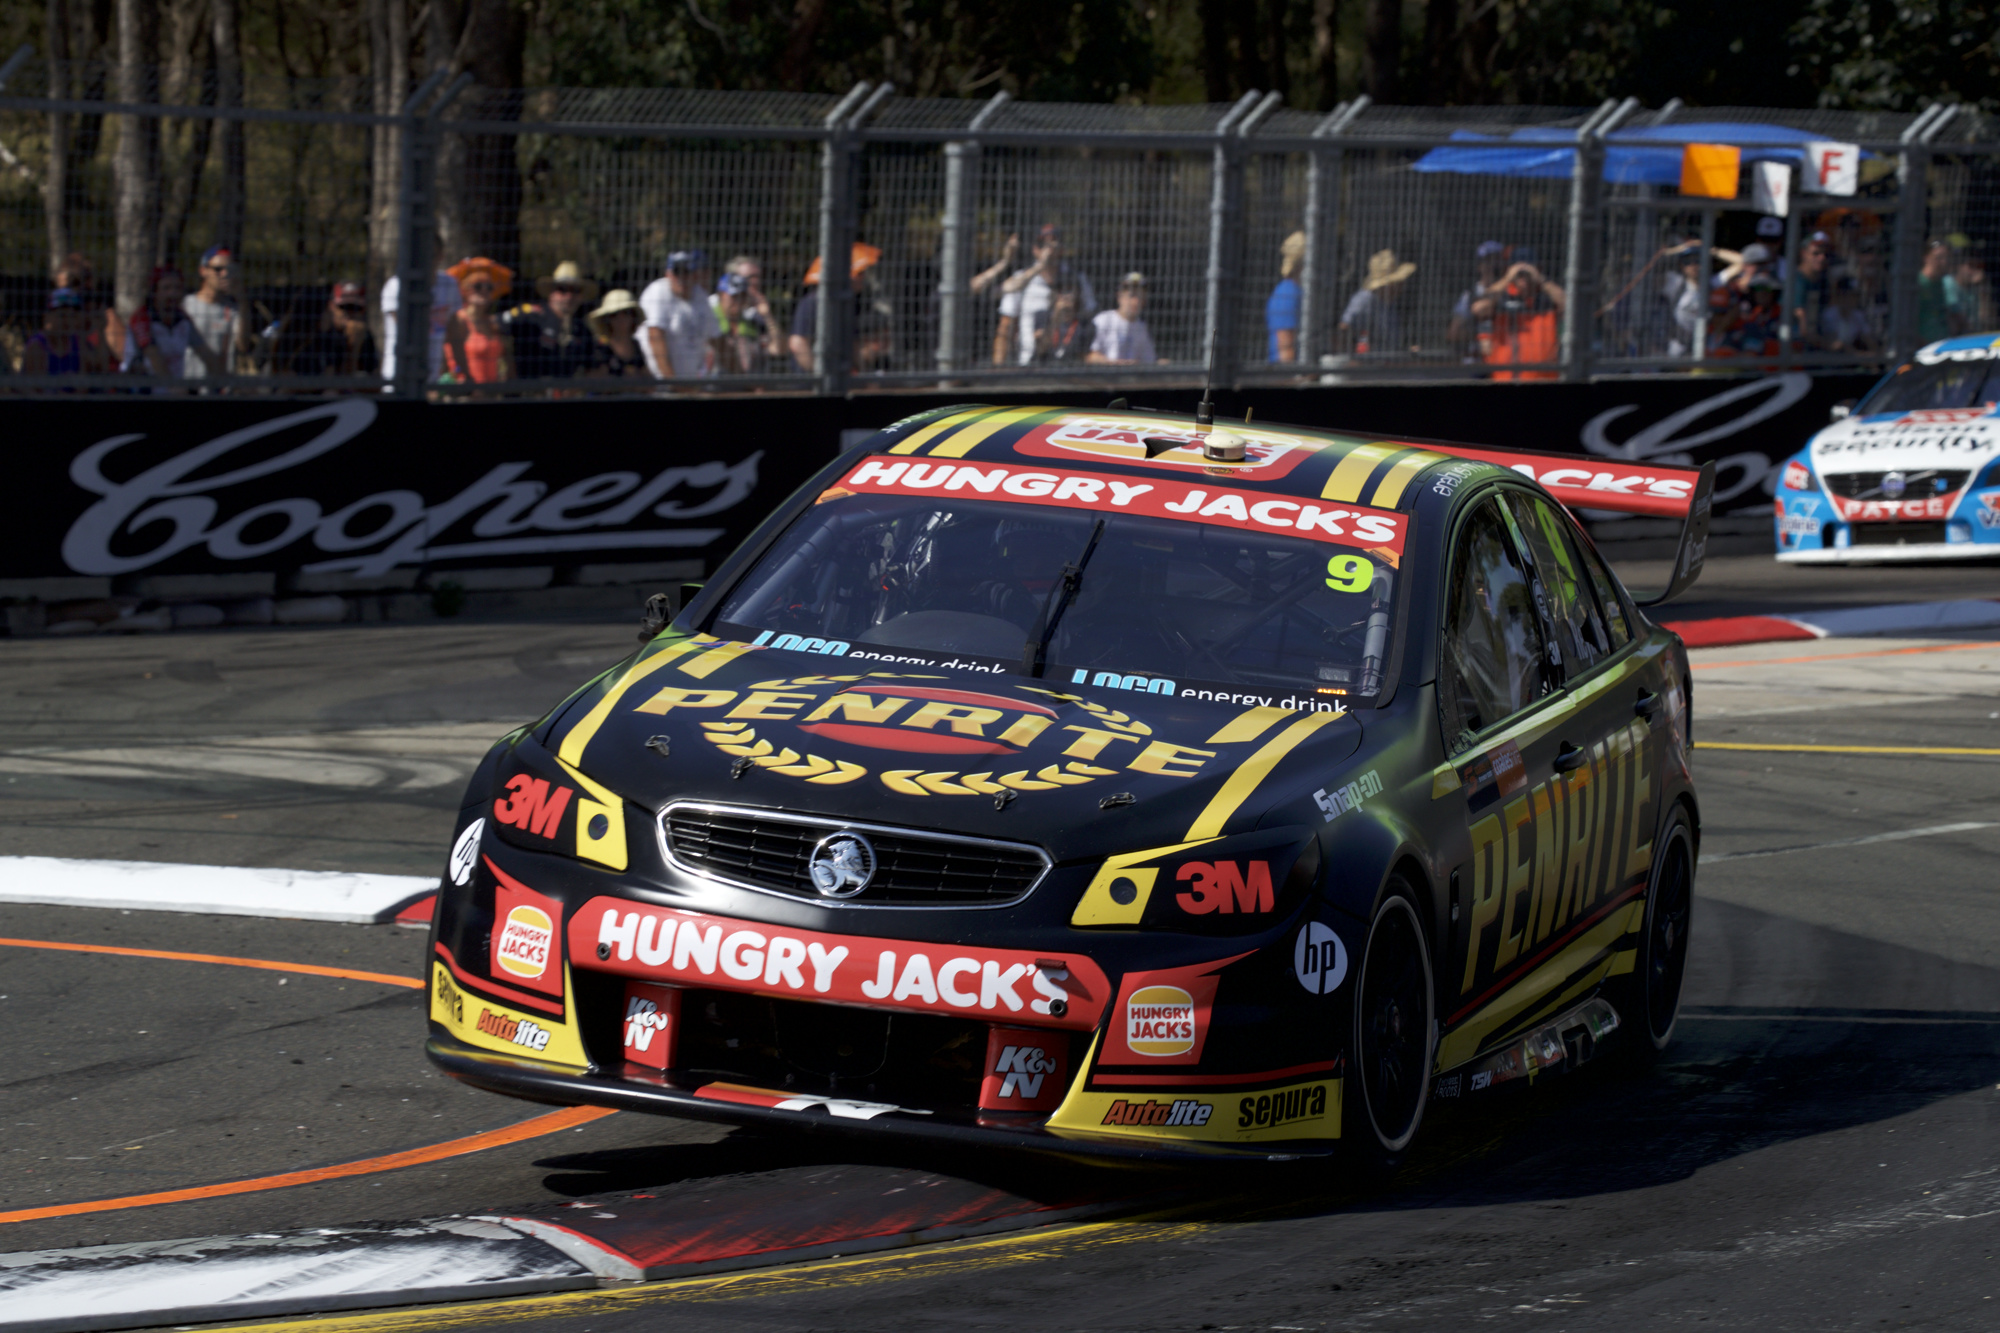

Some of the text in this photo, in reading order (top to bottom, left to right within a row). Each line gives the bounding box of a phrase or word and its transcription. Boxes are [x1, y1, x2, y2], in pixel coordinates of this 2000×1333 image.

[1819, 151, 1843, 185] F
[1819, 436, 1993, 454] Security
[61, 399, 764, 578] Coopers
[848, 460, 1398, 543] HUNGRY JACK'S
[1325, 554, 1374, 593] 9
[1280, 695, 1348, 714] drink
[633, 686, 1218, 779] PENRITE
[493, 773, 574, 840] 3M
[1313, 769, 1384, 822] Snap-on
[1461, 714, 1653, 996] PENRITE
[1175, 860, 1275, 915] 3M
[505, 923, 549, 945] HUNGRY
[597, 908, 1069, 1016] HUNGRY JACK'S
[1302, 921, 1336, 994] hp
[475, 1008, 551, 1051] Autolite
[1131, 1007, 1191, 1019] HUNGRY
[1131, 1021, 1192, 1039] JACK'S
[1101, 1099, 1213, 1127] Autolite
[1238, 1085, 1326, 1128] sepura
